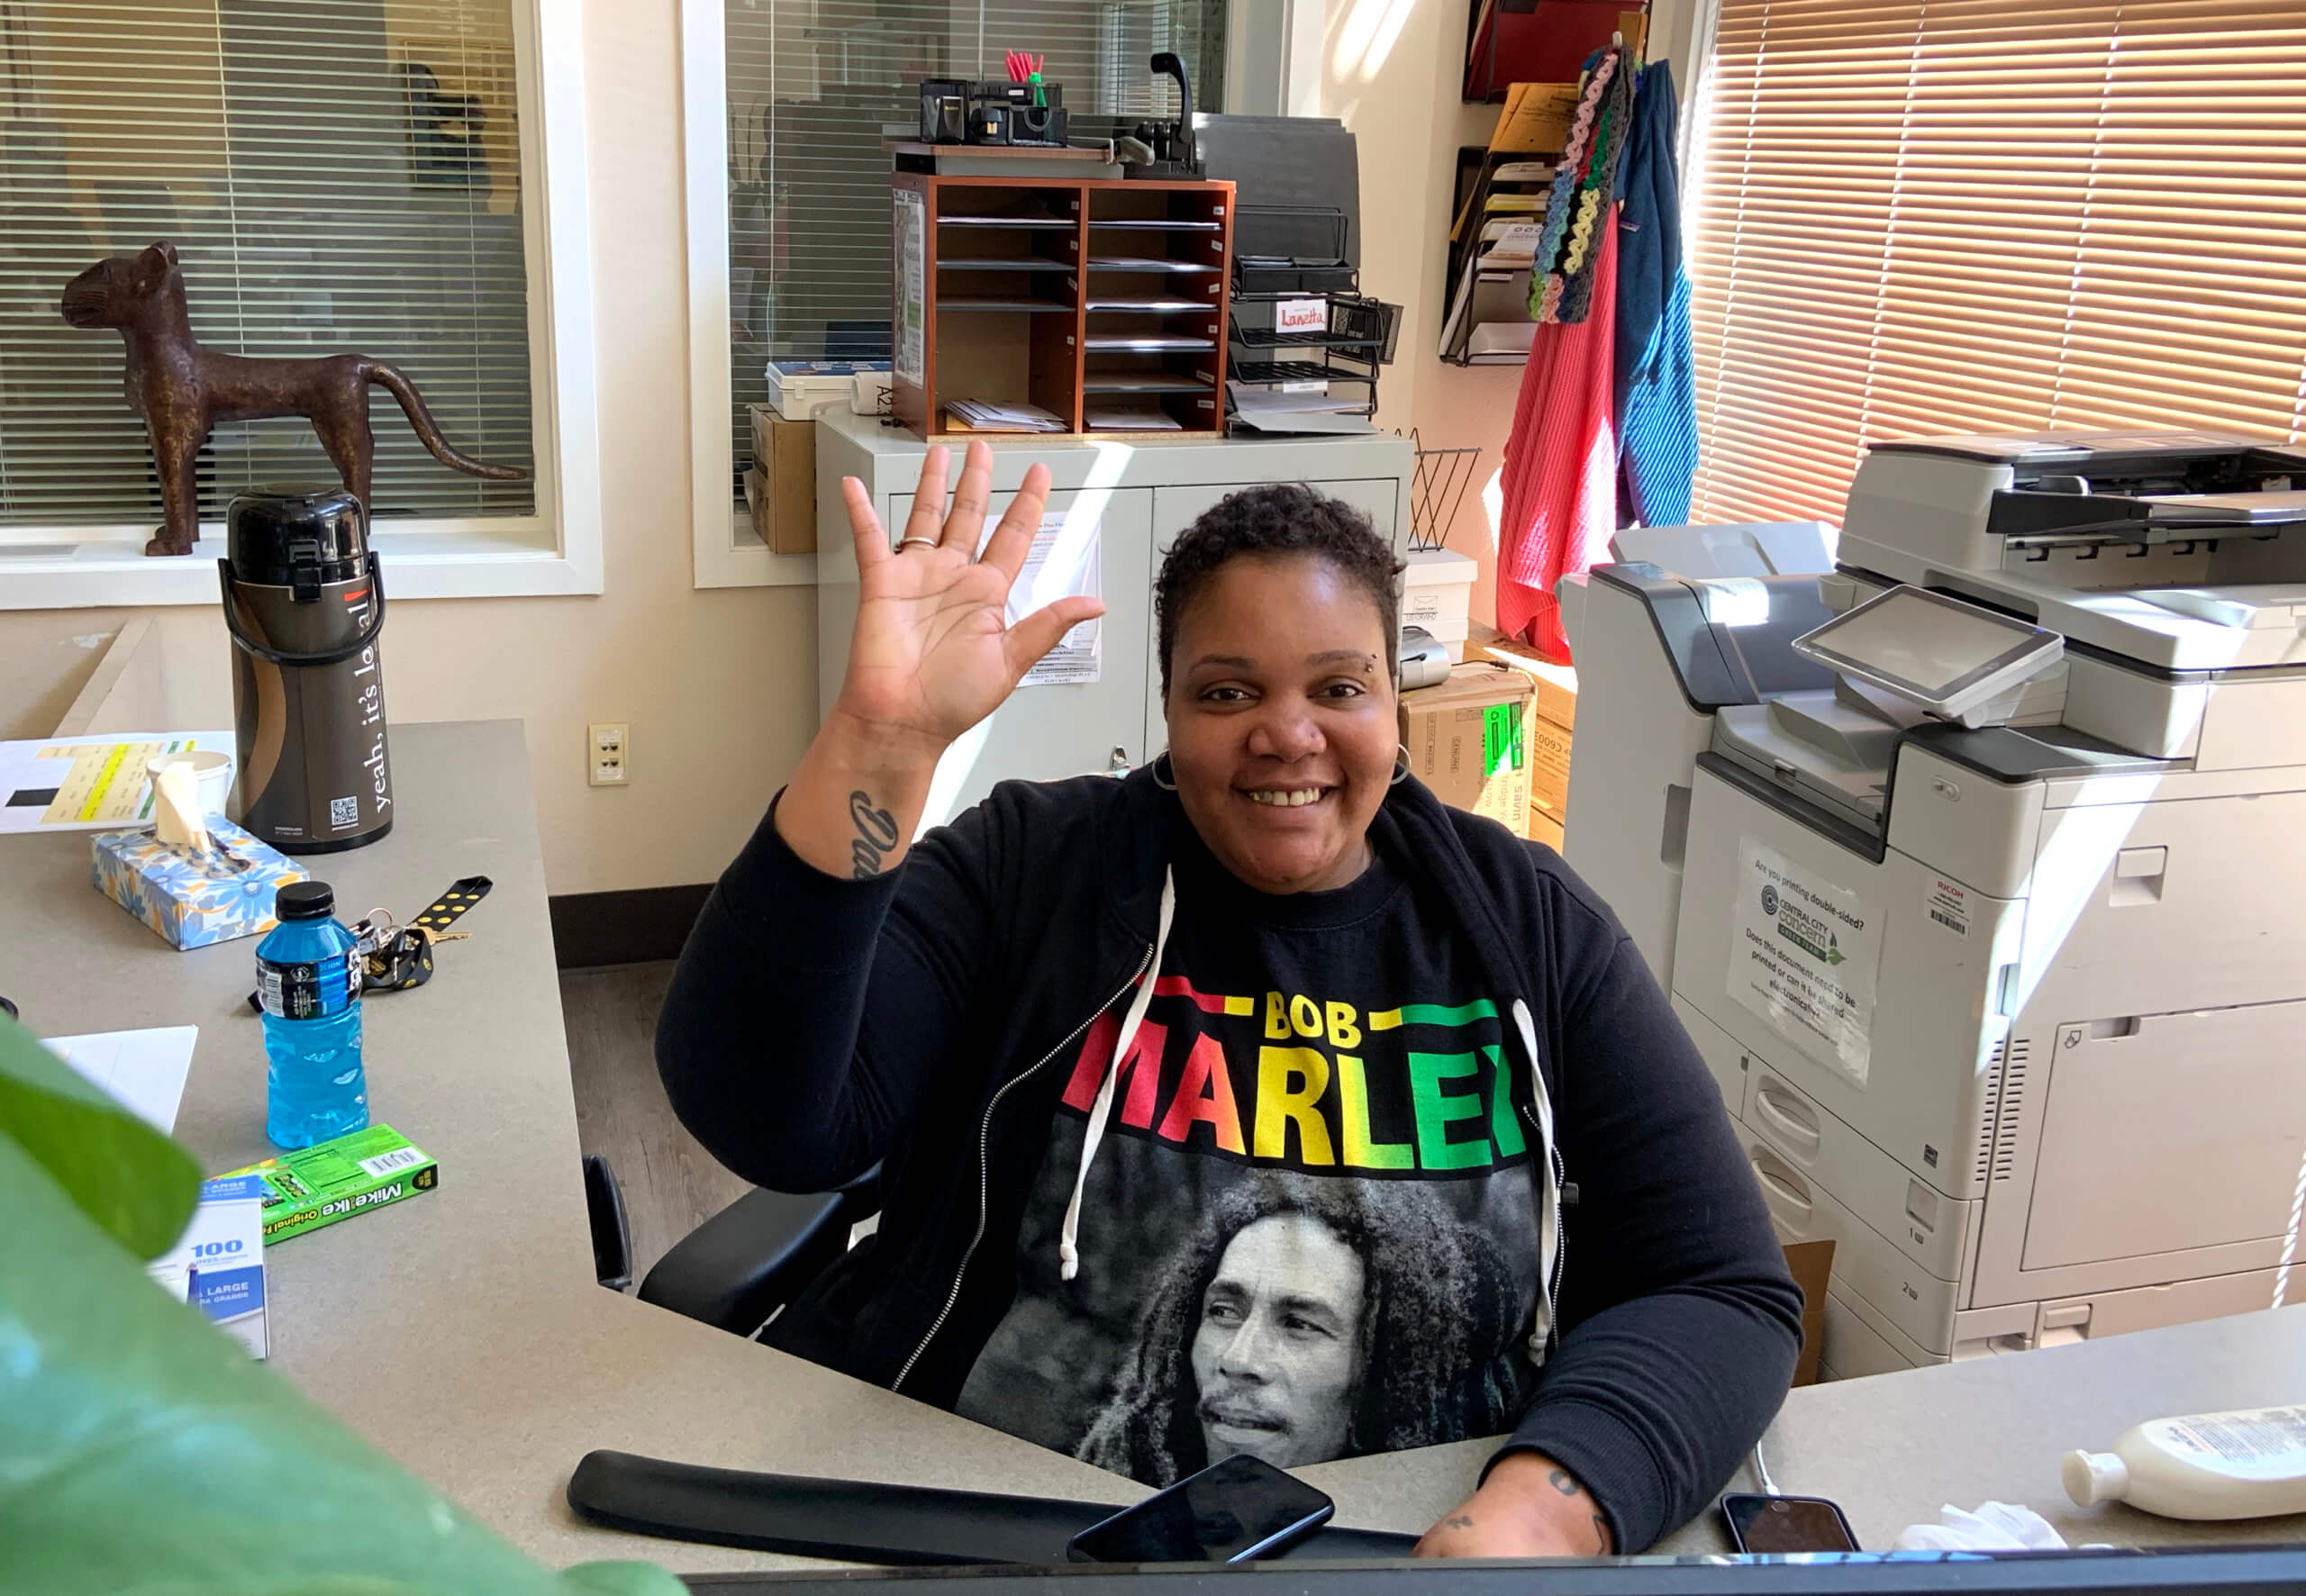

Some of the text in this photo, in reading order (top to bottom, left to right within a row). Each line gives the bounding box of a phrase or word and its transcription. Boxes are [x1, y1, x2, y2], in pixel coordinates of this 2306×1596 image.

[1281, 306, 1325, 327] Lanetta
[359, 685, 380, 726] it's
[363, 732, 392, 813] yeah,
[1755, 859, 1865, 931] Are you printing double-sided?
[1938, 881, 1964, 899] RICOH
[1778, 910, 1827, 948] concern
[1779, 899, 1829, 935] CENTRAL CITY
[1746, 928, 1763, 946] Does
[1764, 939, 1776, 955] this
[1777, 949, 1813, 980] document
[1834, 987, 1843, 1000] to
[1845, 993, 1857, 1008] be
[1751, 950, 1776, 974] printed
[1777, 969, 1785, 978] or
[1786, 974, 1800, 989] can
[1265, 991, 1361, 1049] BOB
[274, 1210, 318, 1233] Original
[1909, 1227, 1913, 1238] 1
[190, 1238, 243, 1258] 100
[207, 1282, 249, 1296] LARGE
[213, 1292, 249, 1303] GRANDE
[1902, 1282, 1909, 1294] 2
